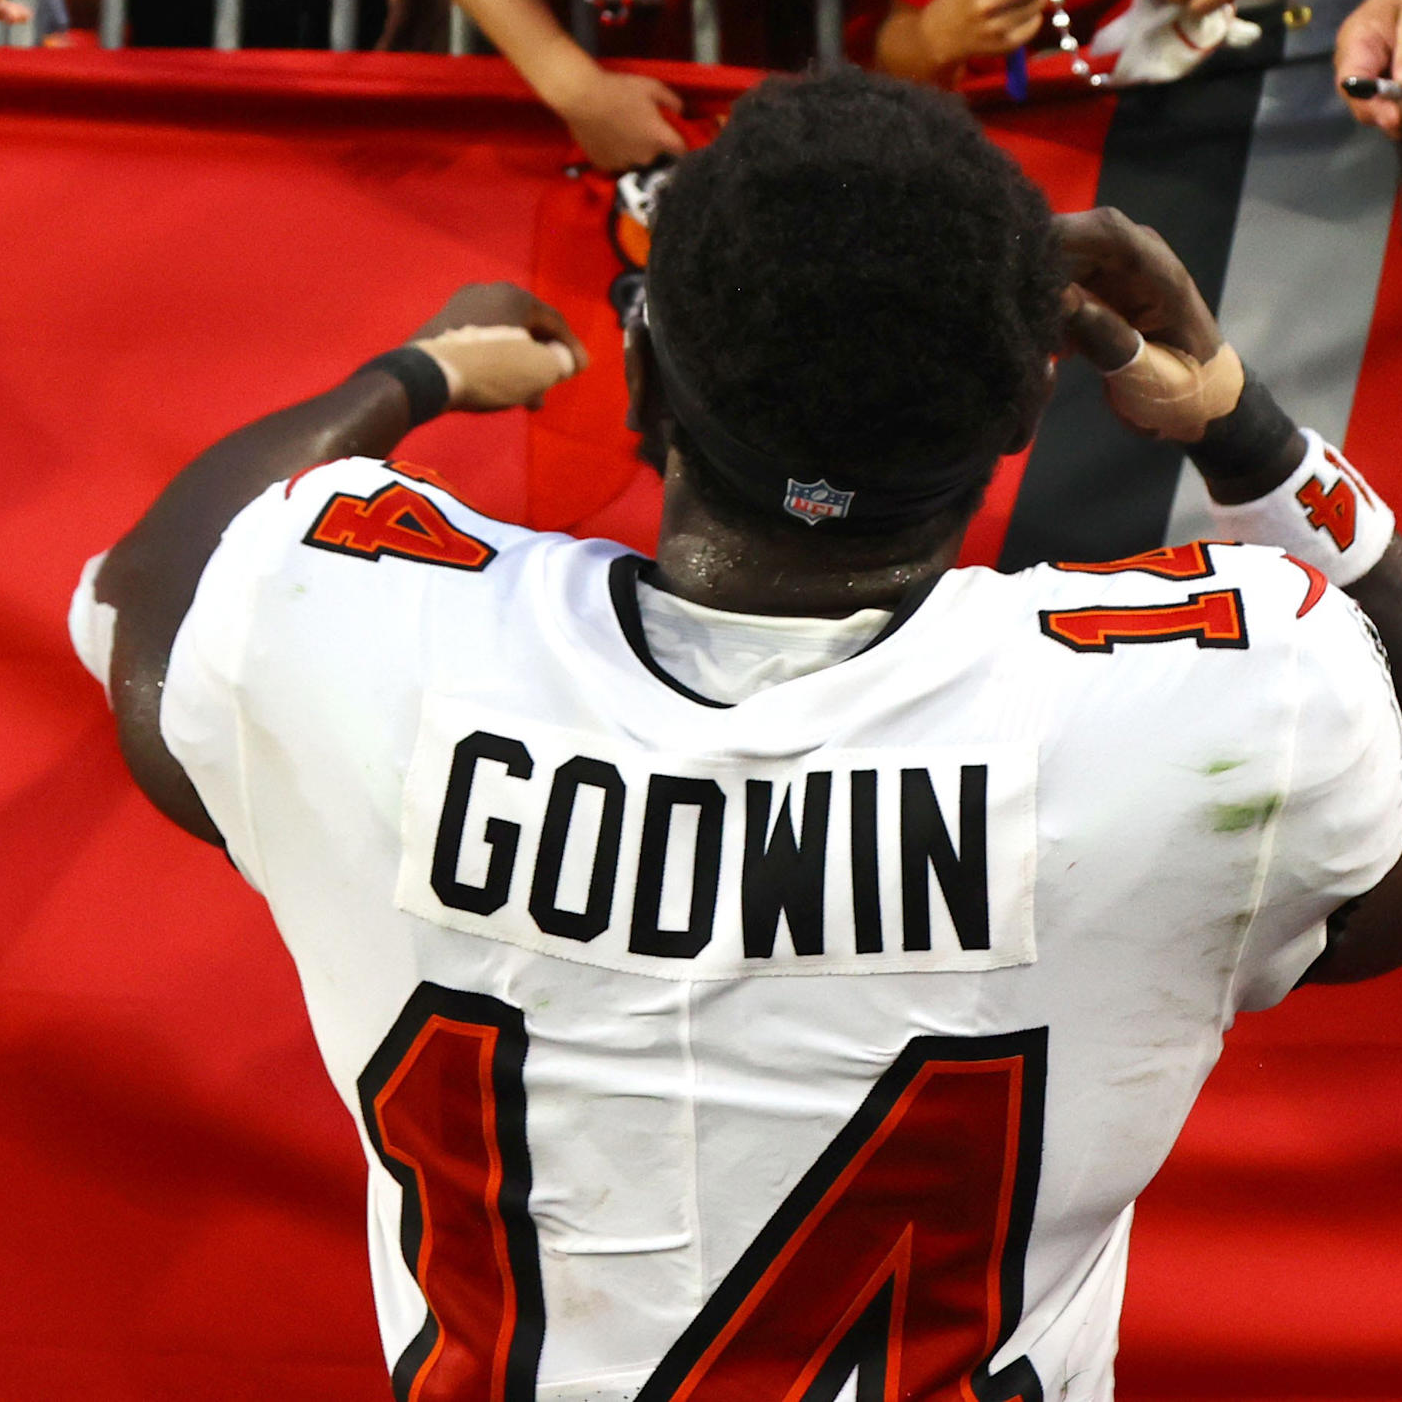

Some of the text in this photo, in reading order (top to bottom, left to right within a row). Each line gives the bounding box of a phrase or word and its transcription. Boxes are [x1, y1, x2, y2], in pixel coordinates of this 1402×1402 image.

[300, 460, 499, 573] 4
[429, 729, 990, 960] GODWIN
[356, 980, 1050, 1402] 14
